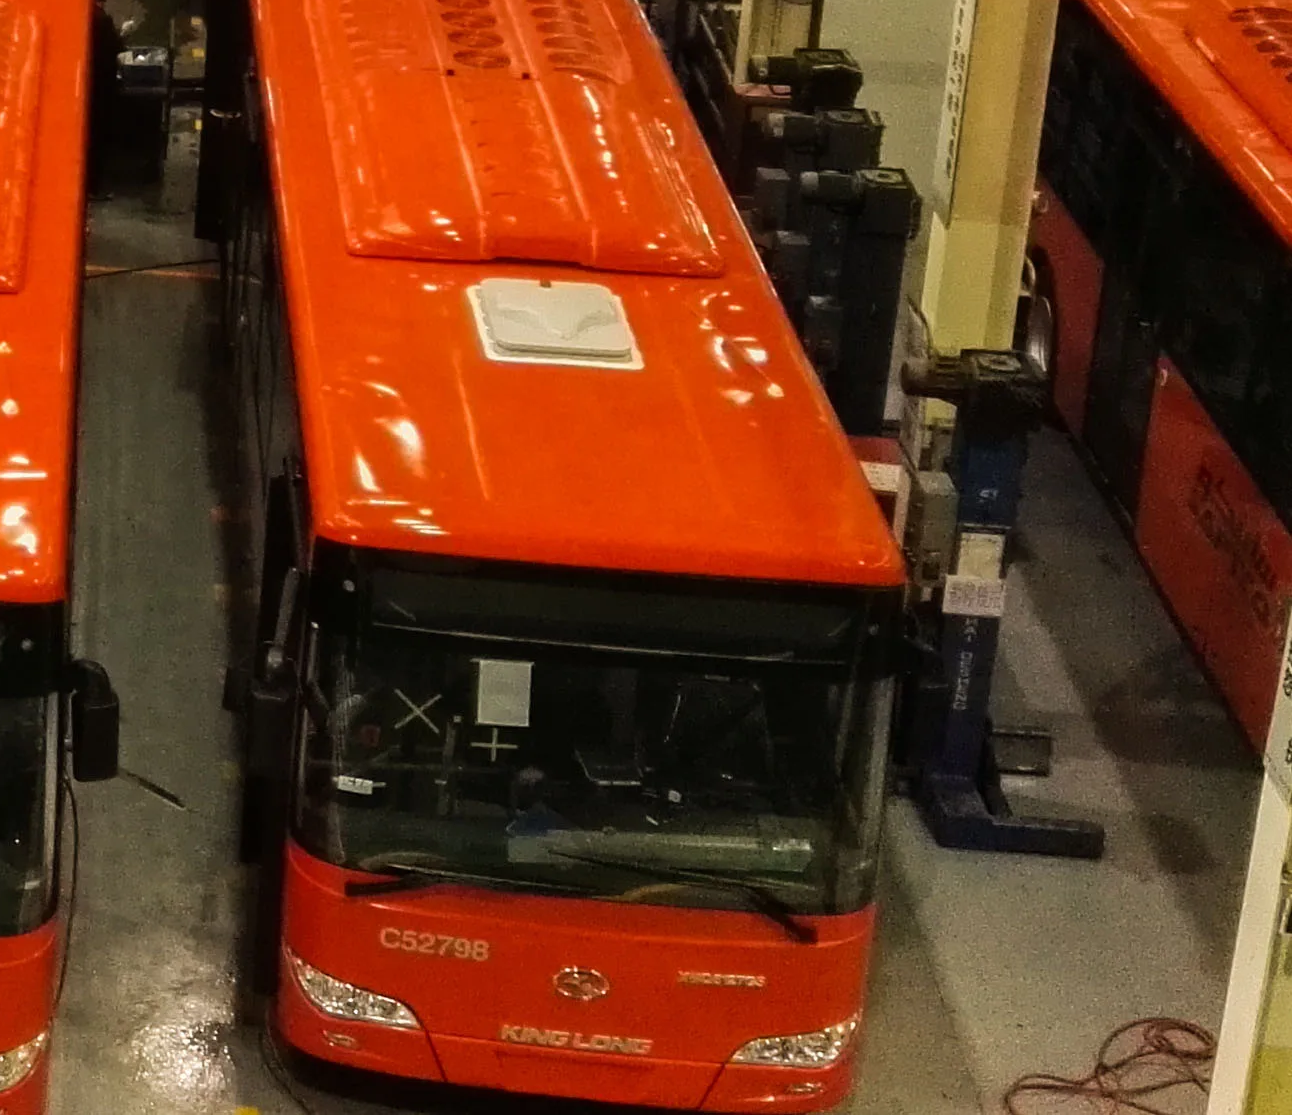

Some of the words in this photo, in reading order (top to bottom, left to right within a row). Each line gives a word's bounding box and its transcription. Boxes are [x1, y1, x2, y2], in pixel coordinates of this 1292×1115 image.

[379, 927, 490, 962] C52798
[501, 1024, 570, 1047] KING
[572, 1032, 653, 1054] LONG
